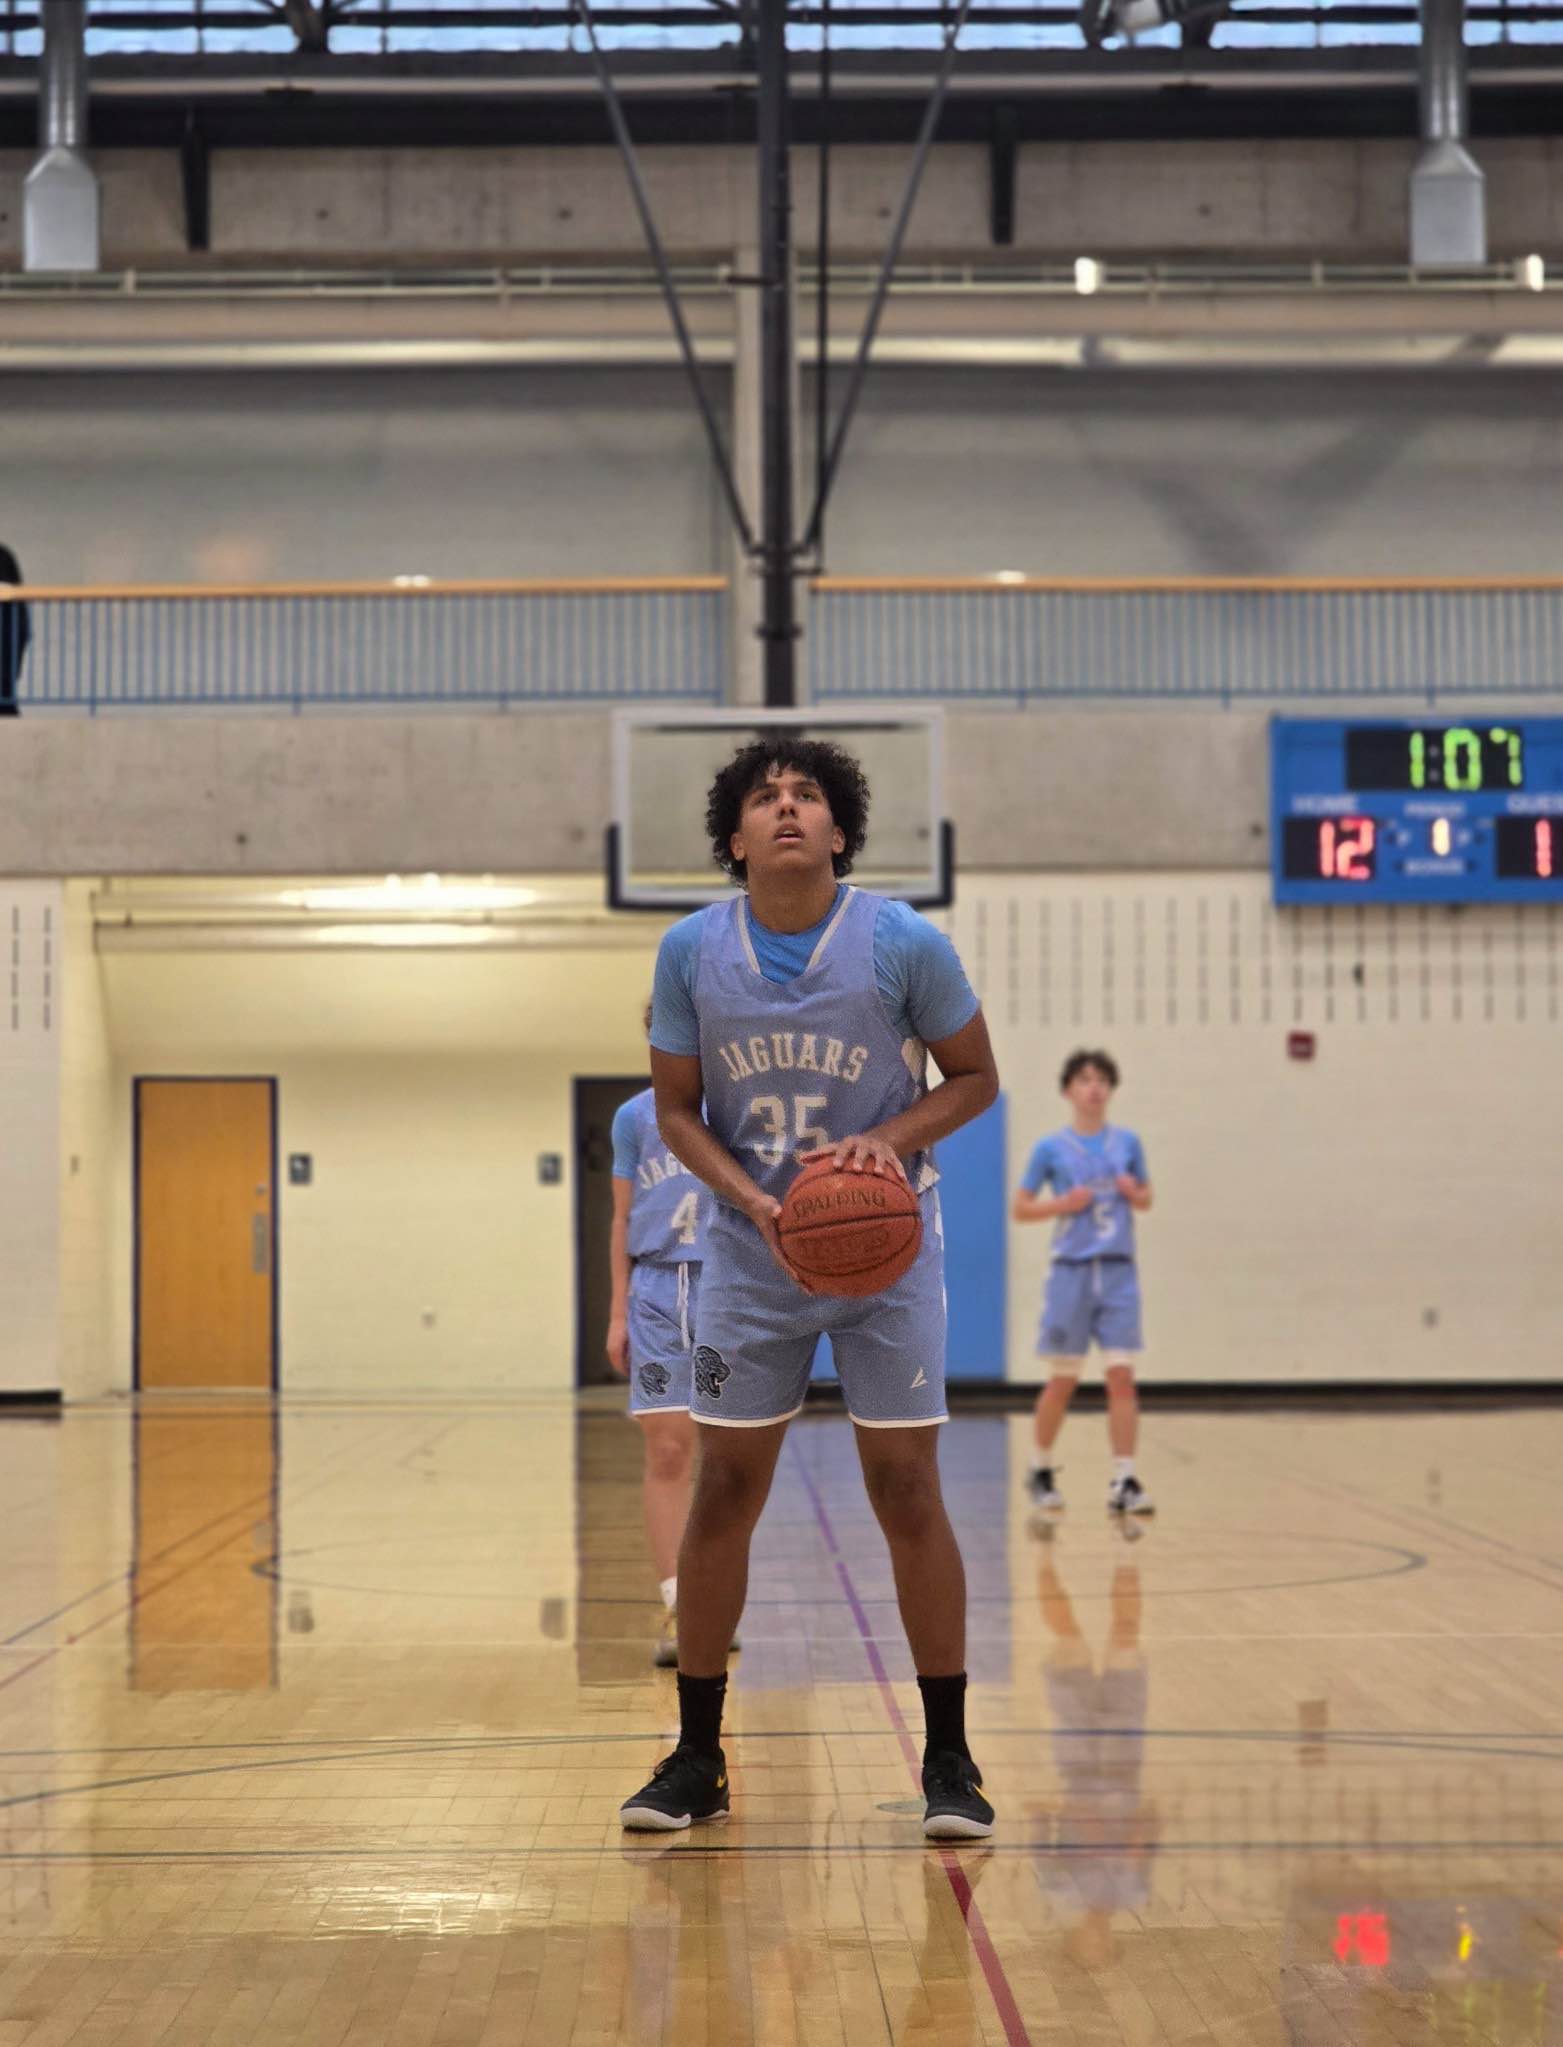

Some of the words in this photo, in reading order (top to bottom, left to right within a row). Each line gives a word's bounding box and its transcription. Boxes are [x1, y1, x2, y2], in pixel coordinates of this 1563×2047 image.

[1409, 727, 1522, 791] 1:07
[1319, 815, 1374, 879] 12
[1432, 816, 1451, 856] 1
[718, 1030, 869, 1083] JAGUARS
[750, 1095, 831, 1168] 35
[636, 1151, 694, 1190] JAG
[670, 1190, 699, 1244] 4
[791, 1188, 887, 1218] SPALDING
